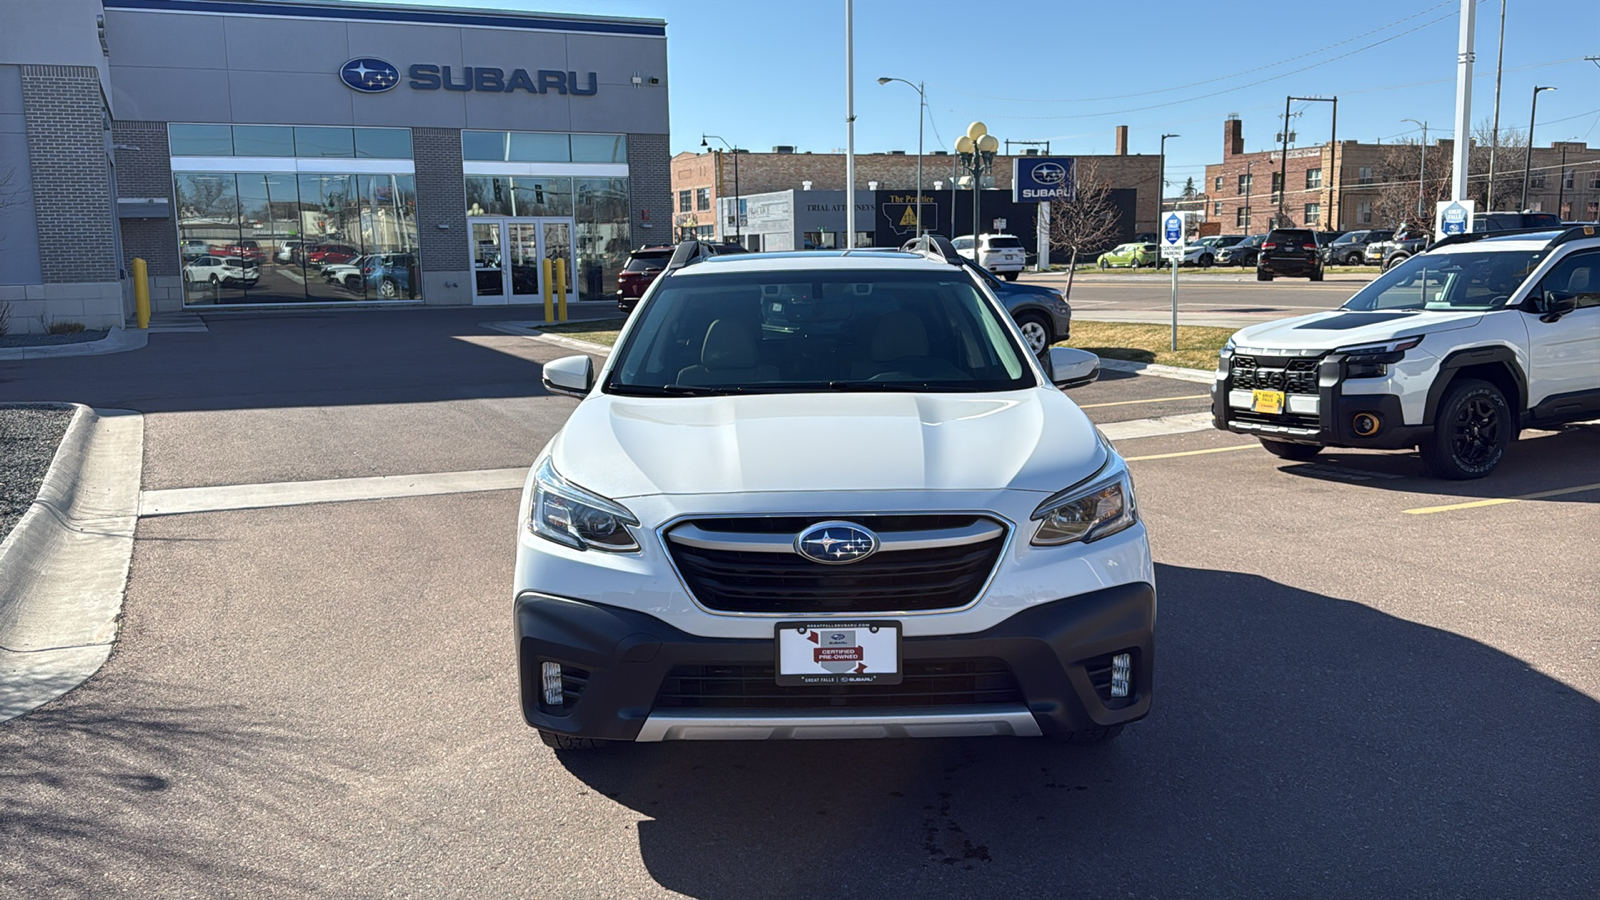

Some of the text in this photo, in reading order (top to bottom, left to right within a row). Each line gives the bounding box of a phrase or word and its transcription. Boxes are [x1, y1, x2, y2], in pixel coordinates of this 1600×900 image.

[408, 63, 598, 96] SUBARU
[1022, 188, 1071, 198] SUBARU
[890, 195, 934, 203] The Pratice
[832, 203, 875, 212] ATTNEYS
